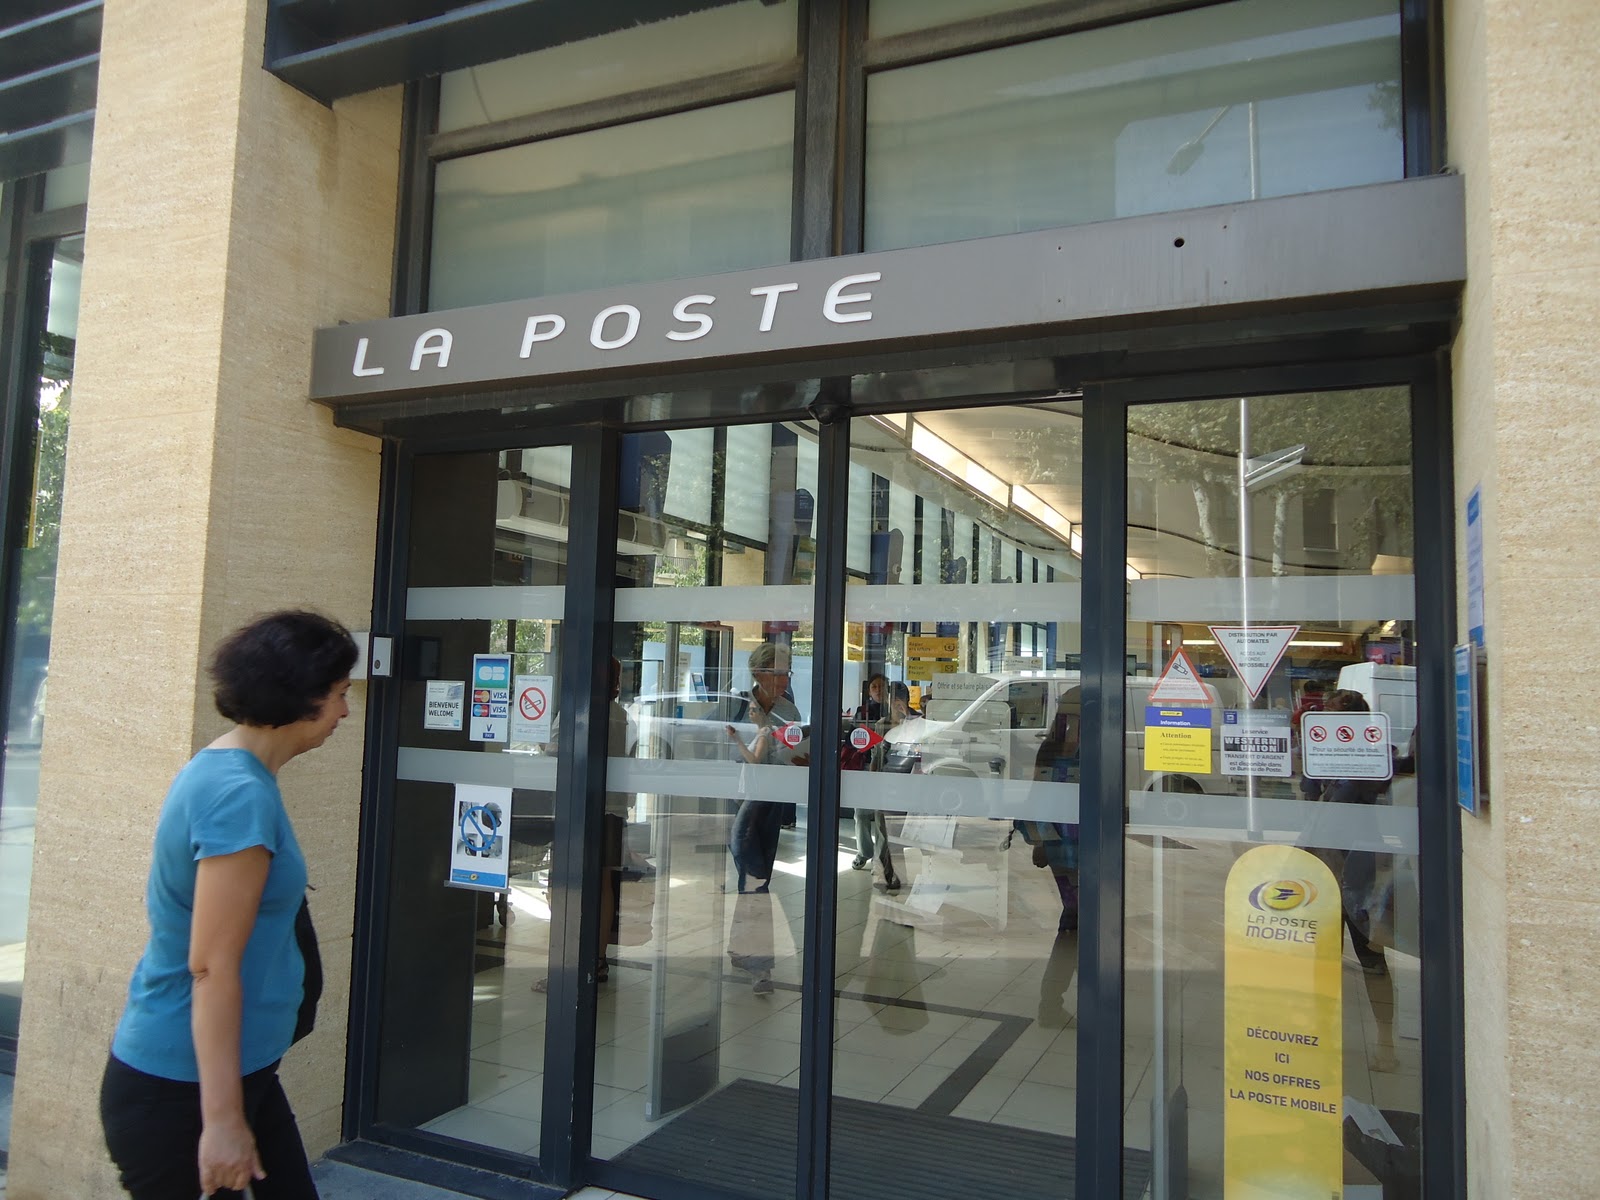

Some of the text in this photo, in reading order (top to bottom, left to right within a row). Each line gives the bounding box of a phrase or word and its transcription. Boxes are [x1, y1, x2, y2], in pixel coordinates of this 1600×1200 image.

[352, 270, 882, 378] LA POSTE
[428, 701, 459, 709] BIENVENUE
[1224, 737, 1277, 745] WESTERN
[1240, 744, 1277, 752] UNION
[1247, 914, 1318, 930] LA POSTE
[1246, 925, 1317, 943] MOBILE
[1246, 1026, 1319, 1047] DÉCOUVREZ
[1274, 1052, 1290, 1064] ICI
[1245, 1069, 1321, 1090] NOS OFFRES
[1229, 1088, 1337, 1115] LA POSTE MOBILE
